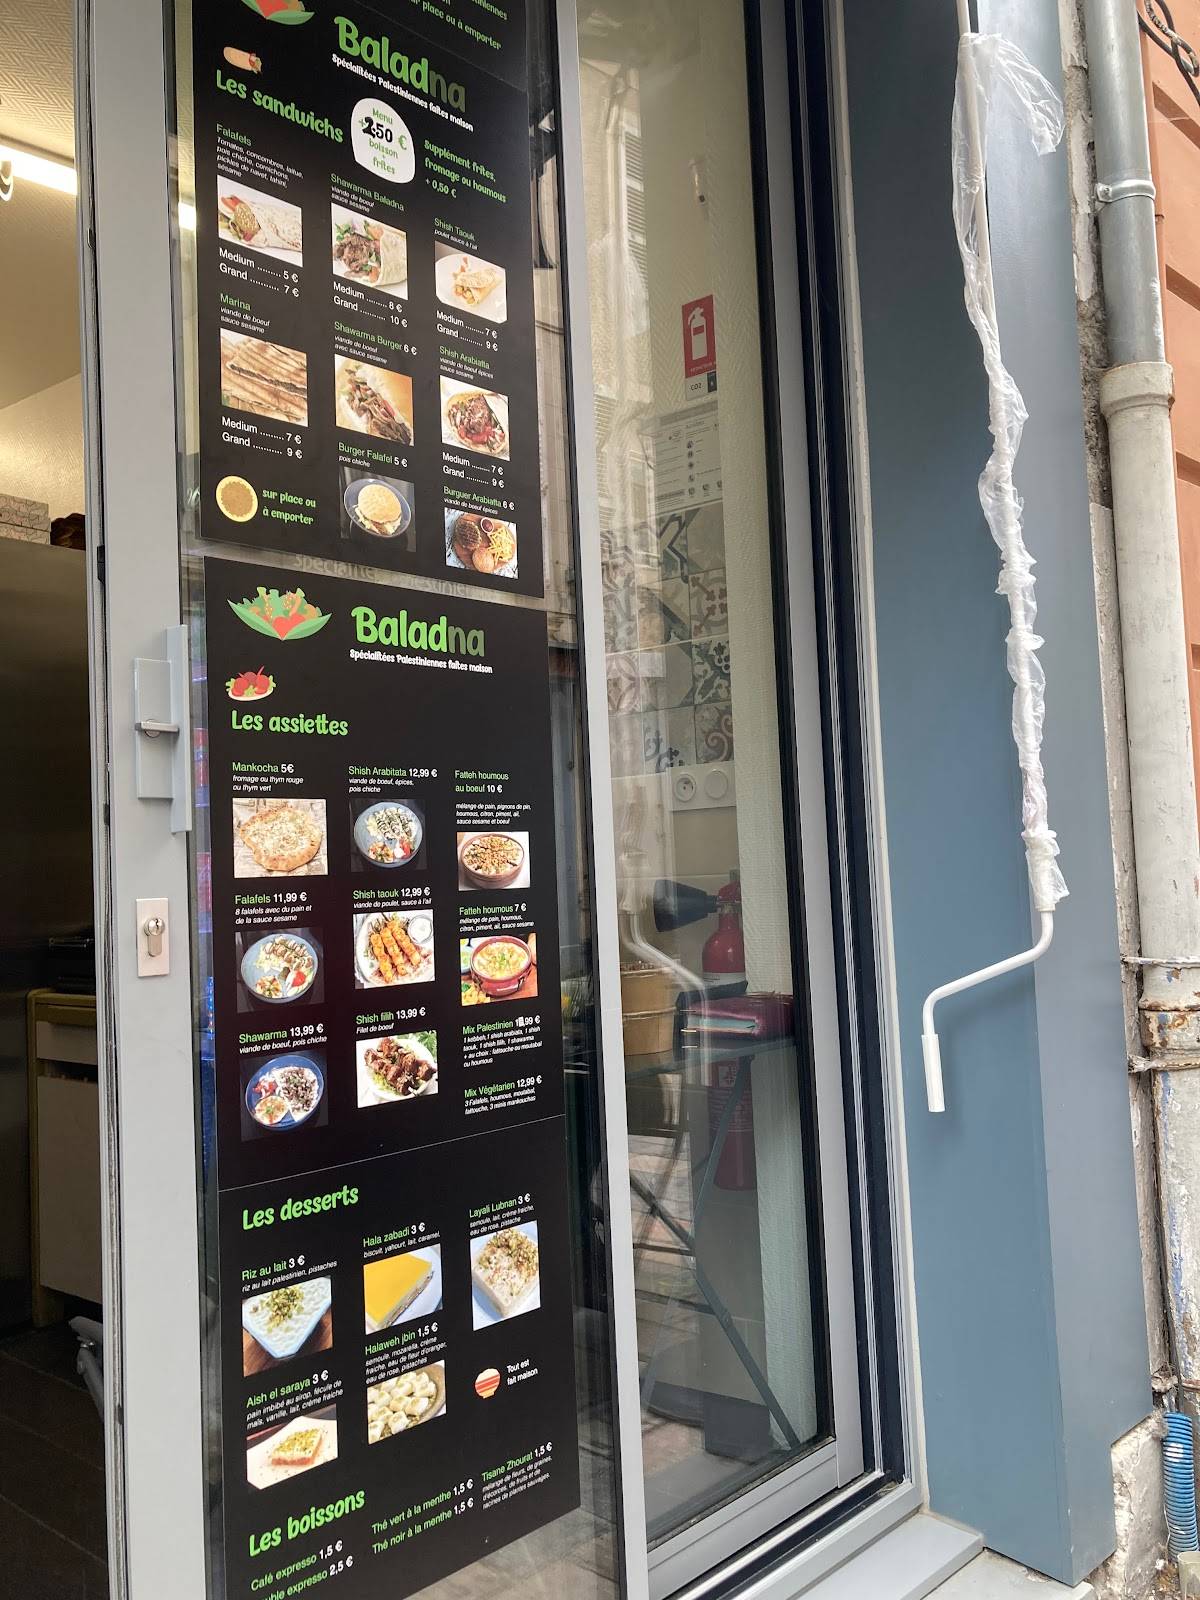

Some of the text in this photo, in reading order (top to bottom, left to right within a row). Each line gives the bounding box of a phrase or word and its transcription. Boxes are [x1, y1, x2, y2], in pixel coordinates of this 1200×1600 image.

[334, 16, 466, 112] Baladna
[217, 70, 343, 142] Les sandwichs
[372, 108, 393, 124] Menu
[378, 77, 427, 108] Palestiniennes
[450, 115, 473, 132] maison
[216, 124, 251, 147] Falafels
[398, 135, 407, 150] €
[369, 138, 398, 159] boisson
[424, 140, 470, 169] Supplément
[425, 157, 506, 202] fromage ou houmous
[432, 181, 449, 195] 0,50
[451, 188, 457, 198] €
[331, 174, 405, 212] Shawarma Baladna
[434, 218, 476, 241] Shish Taouk
[219, 248, 299, 283] Medium 5 €
[219, 263, 299, 297] Grand 7 €
[220, 293, 251, 311] Marina
[333, 281, 402, 312] Medium 8 €
[333, 295, 408, 327] Grand 10 €
[334, 321, 417, 355] Shawarma Burger 6 €
[690, 383, 702, 391] CO2
[338, 442, 408, 467] Burger Falafel 5 €
[352, 458, 370, 467] chiche
[442, 453, 504, 475] Medium 7 €
[443, 466, 504, 488] Grand 9 €
[262, 488, 316, 508] sur place ou
[262, 506, 312, 524] à emporter
[350, 606, 485, 657] Baladna
[396, 654, 447, 668] Palestiniennes
[469, 664, 492, 673] maison
[232, 710, 348, 735] Les assiettes
[233, 762, 278, 772] Mankocha
[349, 766, 437, 778] Shish Arabitata 12,99 €
[455, 770, 509, 780] Fatteh houmous
[233, 775, 259, 784] fromage
[270, 776, 284, 784] thym
[243, 784, 258, 792] thym
[466, 784, 484, 792] boeuf
[497, 785, 502, 793] €
[236, 892, 307, 904] Falafels 11,99 €
[353, 887, 430, 899] Shish taouk 12,99 €
[460, 903, 526, 915] Fatteh houmous 7 €
[239, 1024, 323, 1043] Shawarma 13,99 €
[240, 1045, 261, 1054] viande
[292, 1039, 306, 1047] pois
[307, 1036, 327, 1044] chiche
[465, 1075, 542, 1098] Mix Végétarien 12,99 €
[243, 1185, 359, 1230] Les desserts
[470, 1193, 530, 1218] Layali Lubnan 3 €
[364, 1222, 425, 1247] Hala zabadi 3 €
[241, 1255, 305, 1281] Riz au lait 3 €
[365, 1323, 438, 1355] Halaweh jbin 1,5 €
[507, 1359, 529, 1374] Tout est
[507, 1368, 538, 1385] fait maison
[247, 1370, 328, 1408] Aish el saraya 3 €
[372, 1479, 473, 1534] Thé vert à la menthe 1,5 €
[249, 1490, 365, 1557] Les boissons
[251, 1540, 342, 1591] Café expresso 1,5 €
